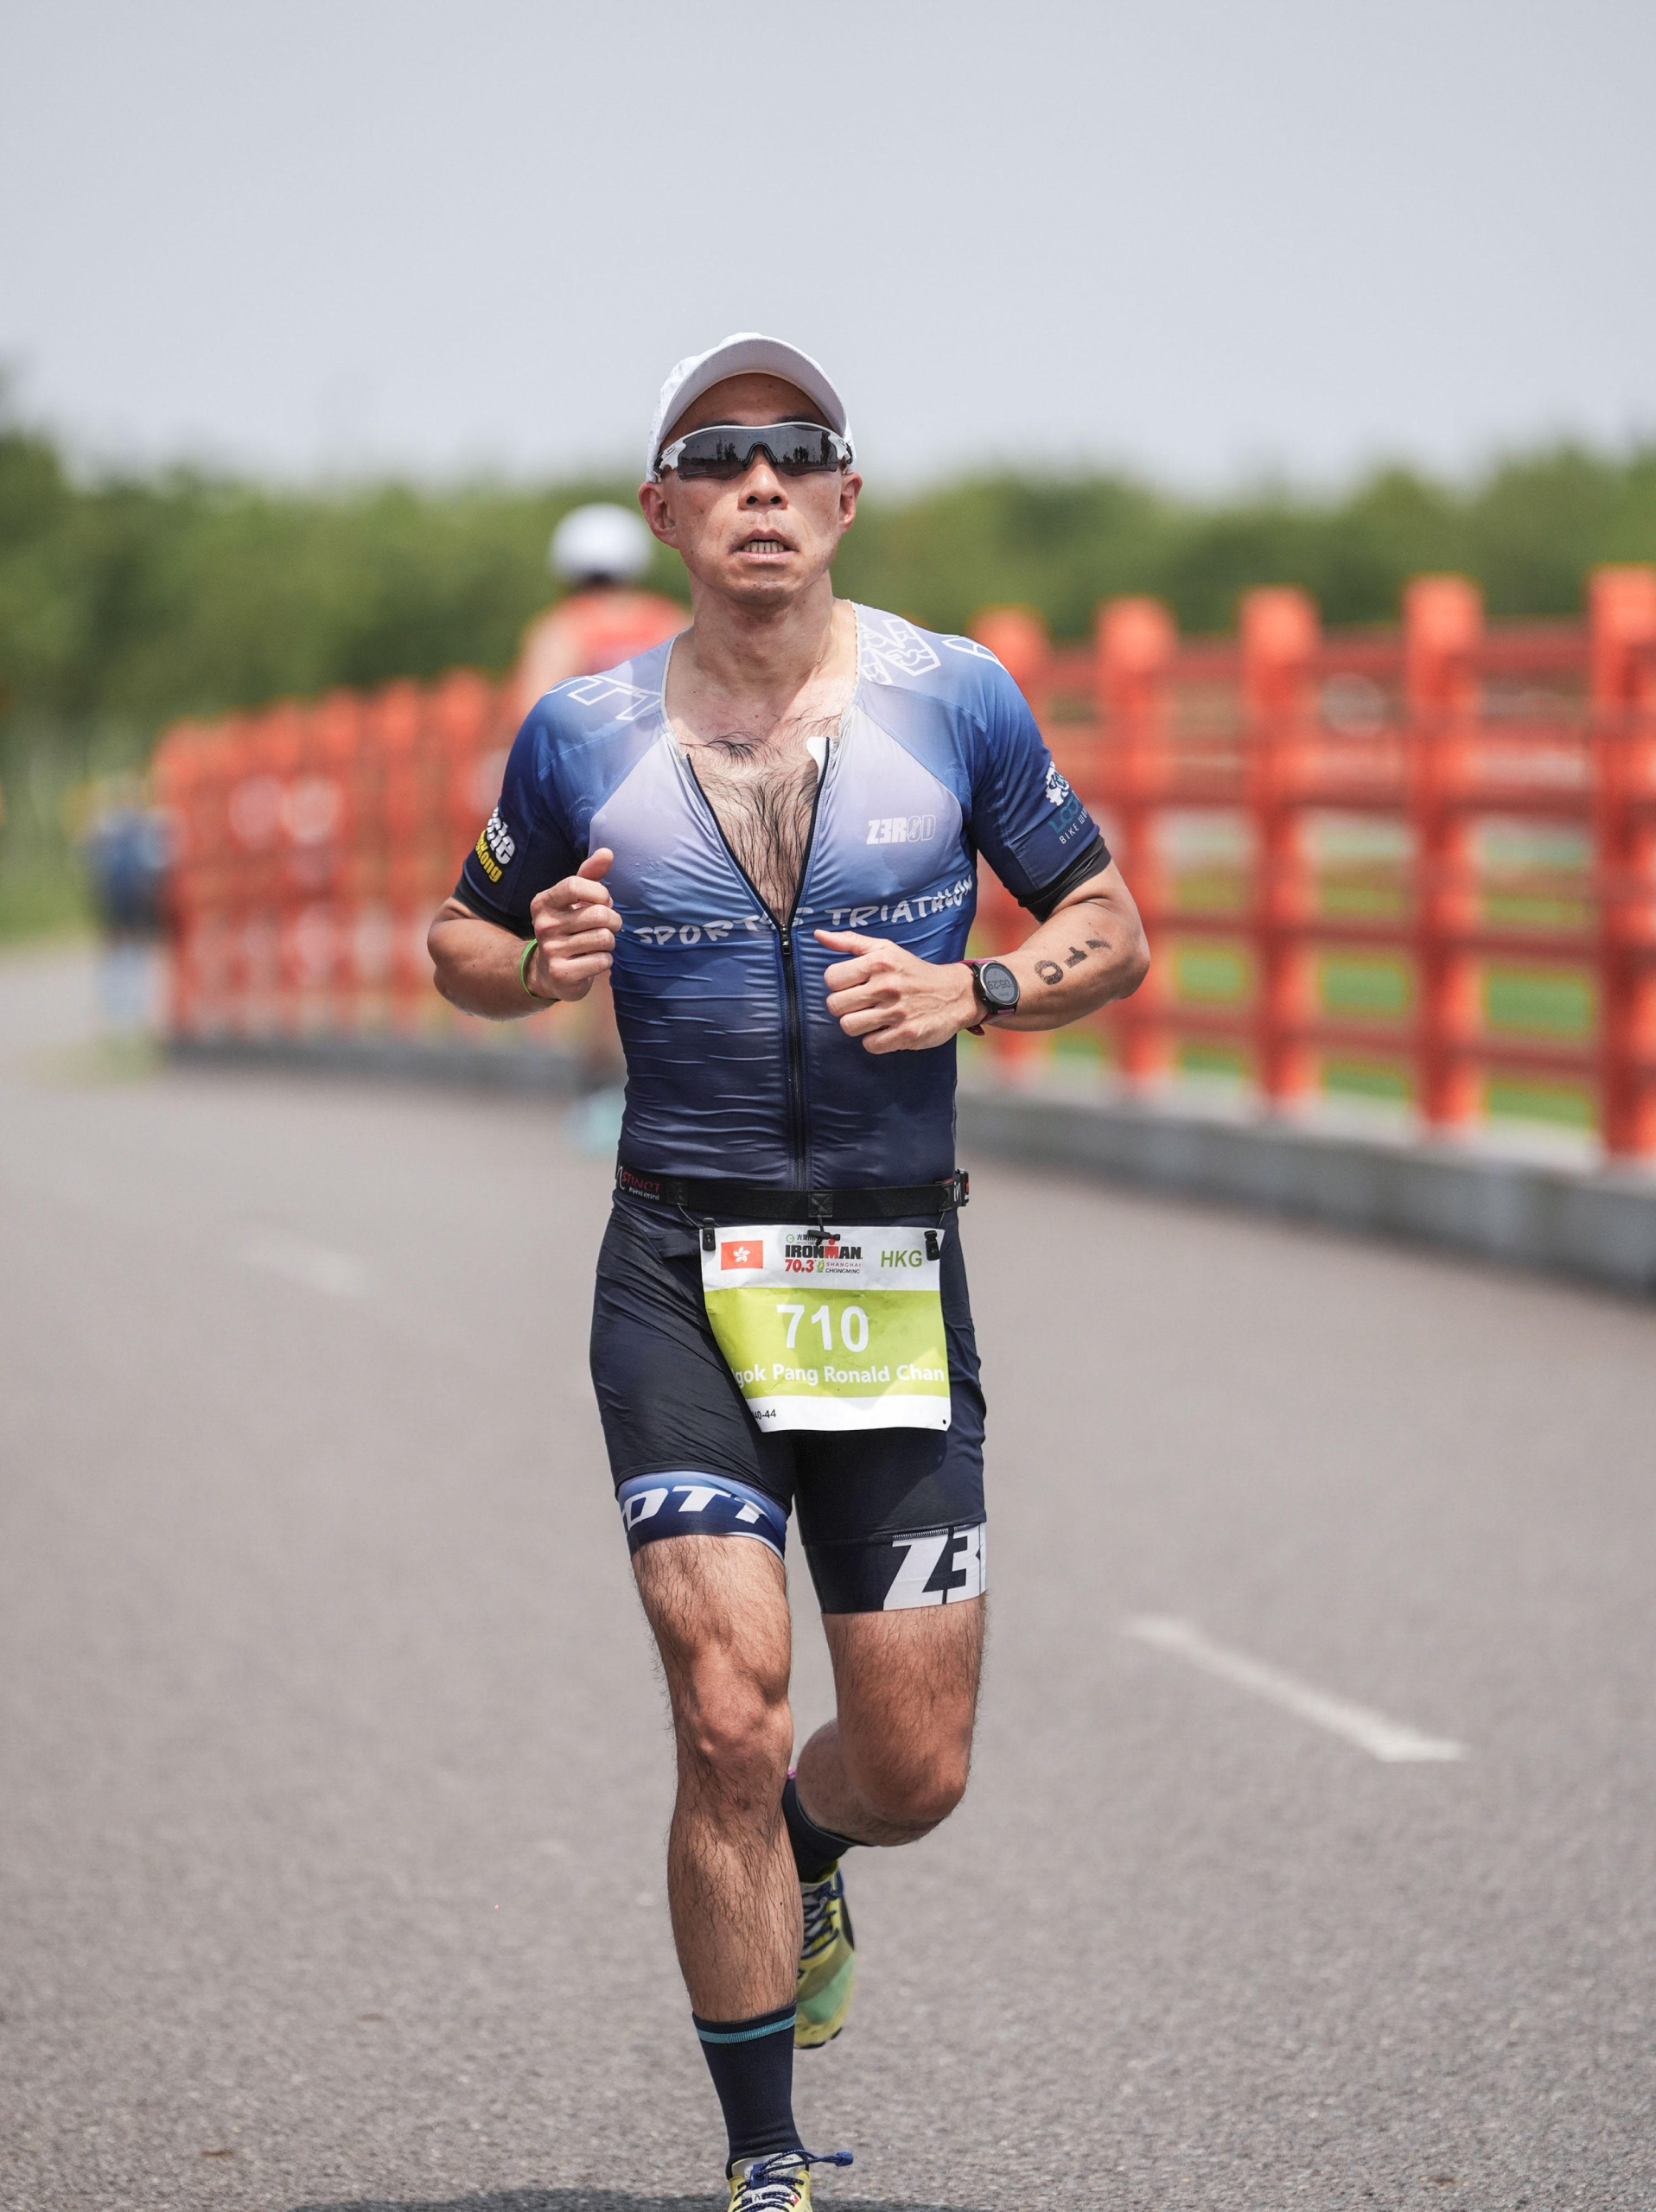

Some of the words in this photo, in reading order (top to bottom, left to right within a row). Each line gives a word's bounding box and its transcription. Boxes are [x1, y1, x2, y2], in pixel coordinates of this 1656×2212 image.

[1058, 822, 1080, 844] BIKE
[825, 874, 972, 928] TRIATHLON
[785, 1244, 862, 1260] IRONMAN
[880, 1250, 923, 1268] HKG
[785, 1259, 814, 1273] 70.3
[777, 1304, 869, 1353] 710
[730, 1363, 767, 1389] gok
[772, 1363, 819, 1387] Pang
[824, 1364, 890, 1384] Ronald
[896, 1363, 945, 1382] Chan
